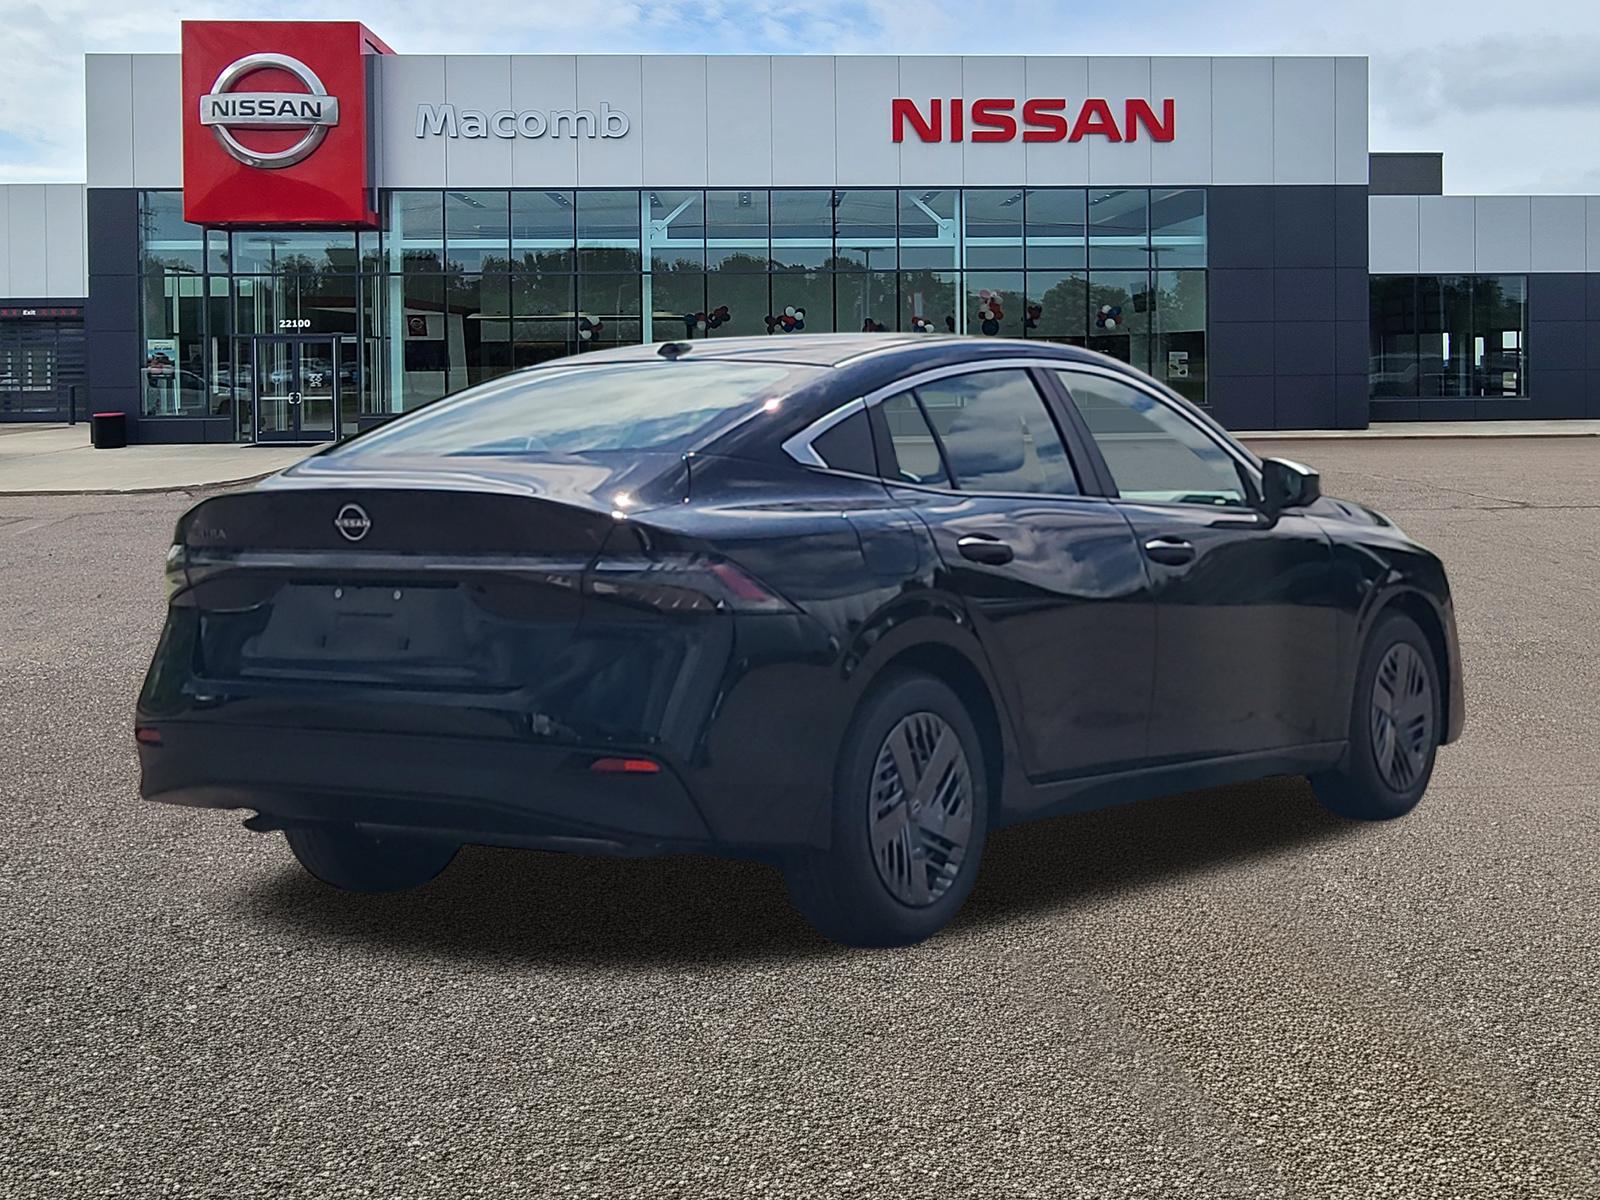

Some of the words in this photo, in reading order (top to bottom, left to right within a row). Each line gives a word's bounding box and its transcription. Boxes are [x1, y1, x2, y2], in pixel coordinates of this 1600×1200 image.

[212, 100, 322, 118] NISSAN
[415, 102, 630, 139] Macomb
[892, 98, 1175, 143] NISSAN
[279, 319, 311, 328] 22100
